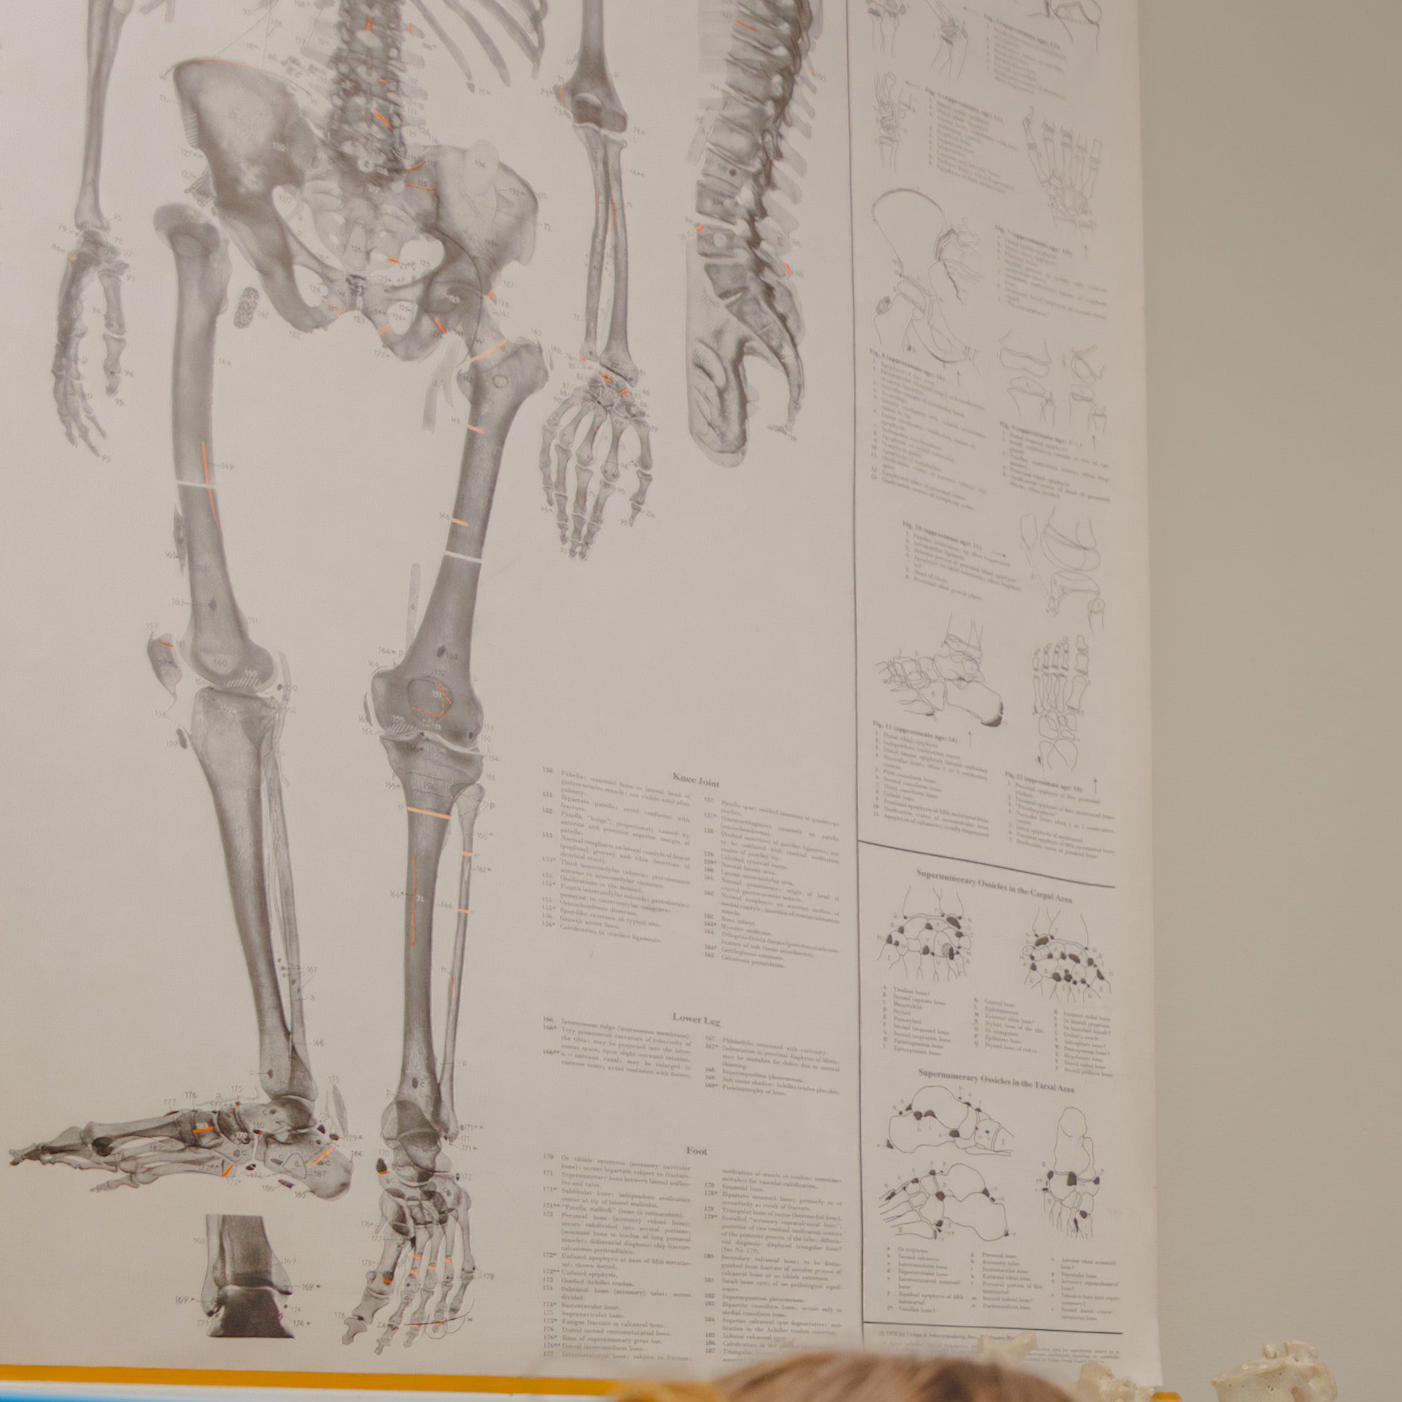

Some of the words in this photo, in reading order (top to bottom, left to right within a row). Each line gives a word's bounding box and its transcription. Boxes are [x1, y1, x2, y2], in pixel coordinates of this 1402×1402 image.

[672, 771, 696, 785] Knee
[698, 775, 720, 788] Joint
[672, 1012, 701, 1024] Lower
[703, 1015, 721, 1027] Leg
[918, 1067, 978, 1083] Supernumerary
[980, 1075, 1010, 1086] Ossicles
[1020, 1080, 1033, 1088] the
[687, 1145, 708, 1156] Foot
